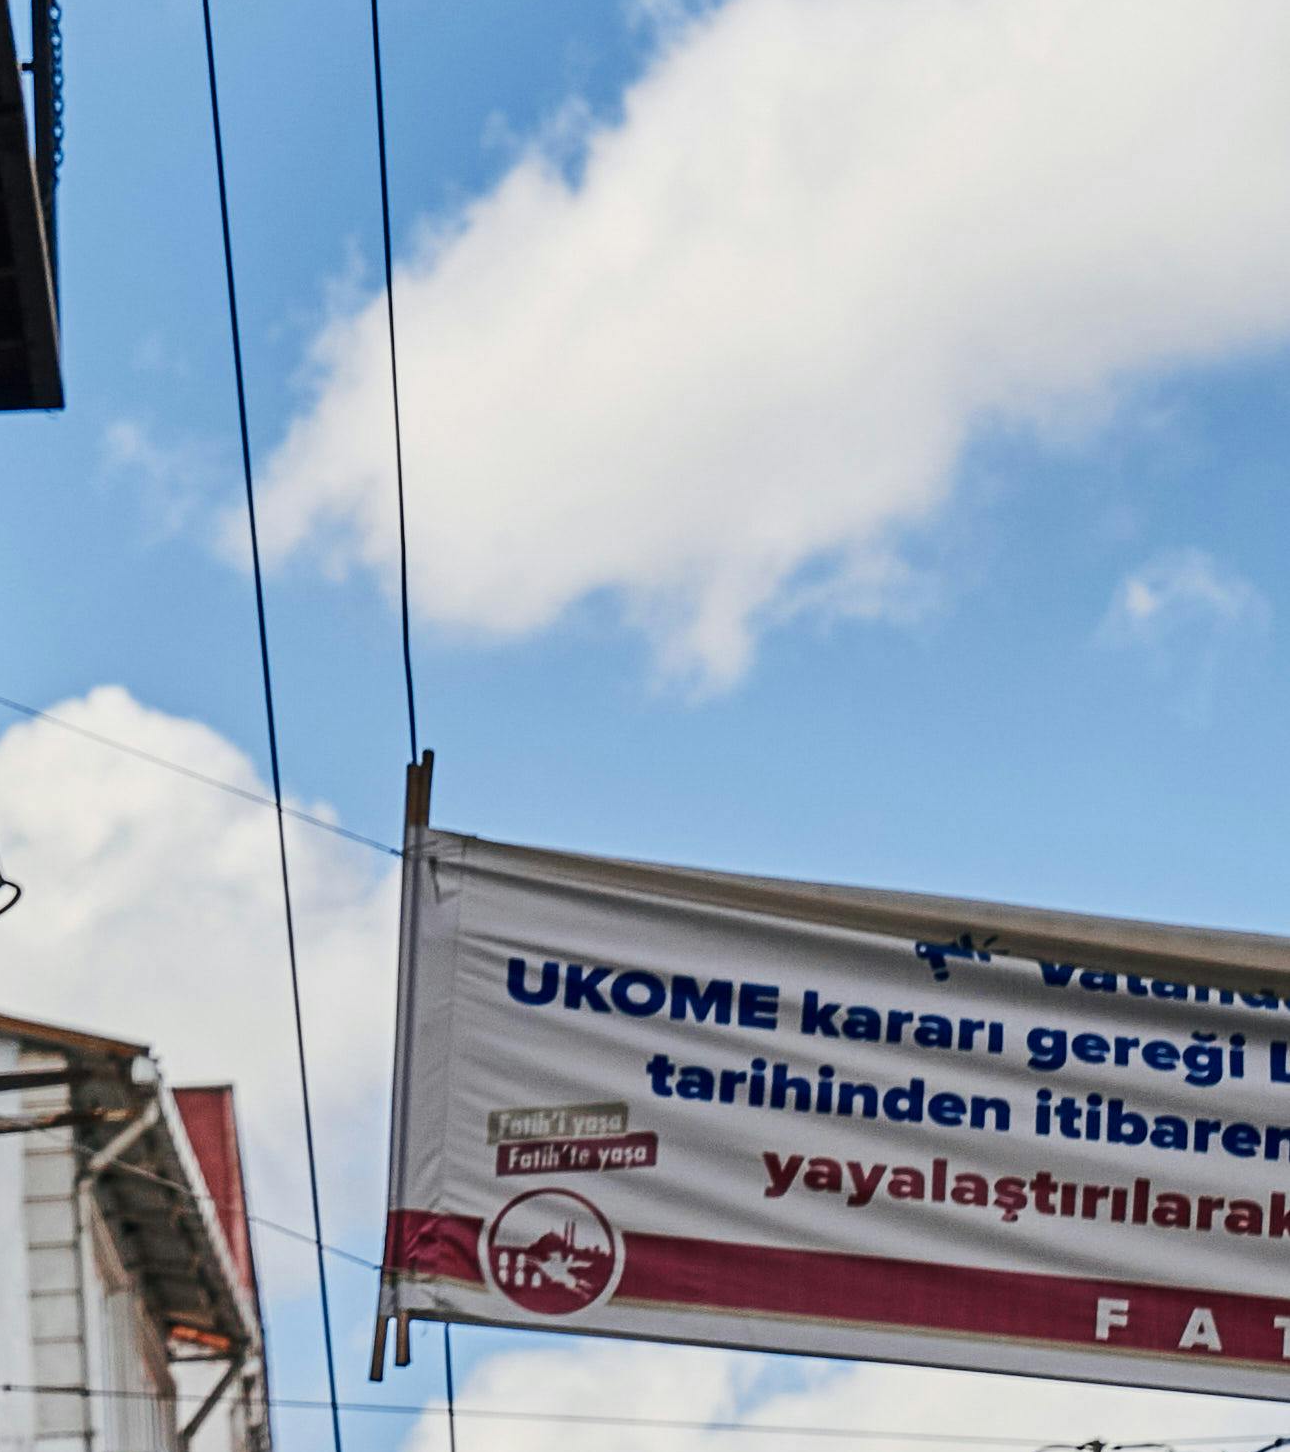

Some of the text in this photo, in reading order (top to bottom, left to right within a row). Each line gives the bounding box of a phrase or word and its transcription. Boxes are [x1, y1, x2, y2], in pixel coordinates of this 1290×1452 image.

[506, 957, 780, 1031] UKOME
[800, 989, 1004, 1055] kararı
[1026, 1026, 1246, 1088] gereği
[645, 1053, 1011, 1133] tarihinden
